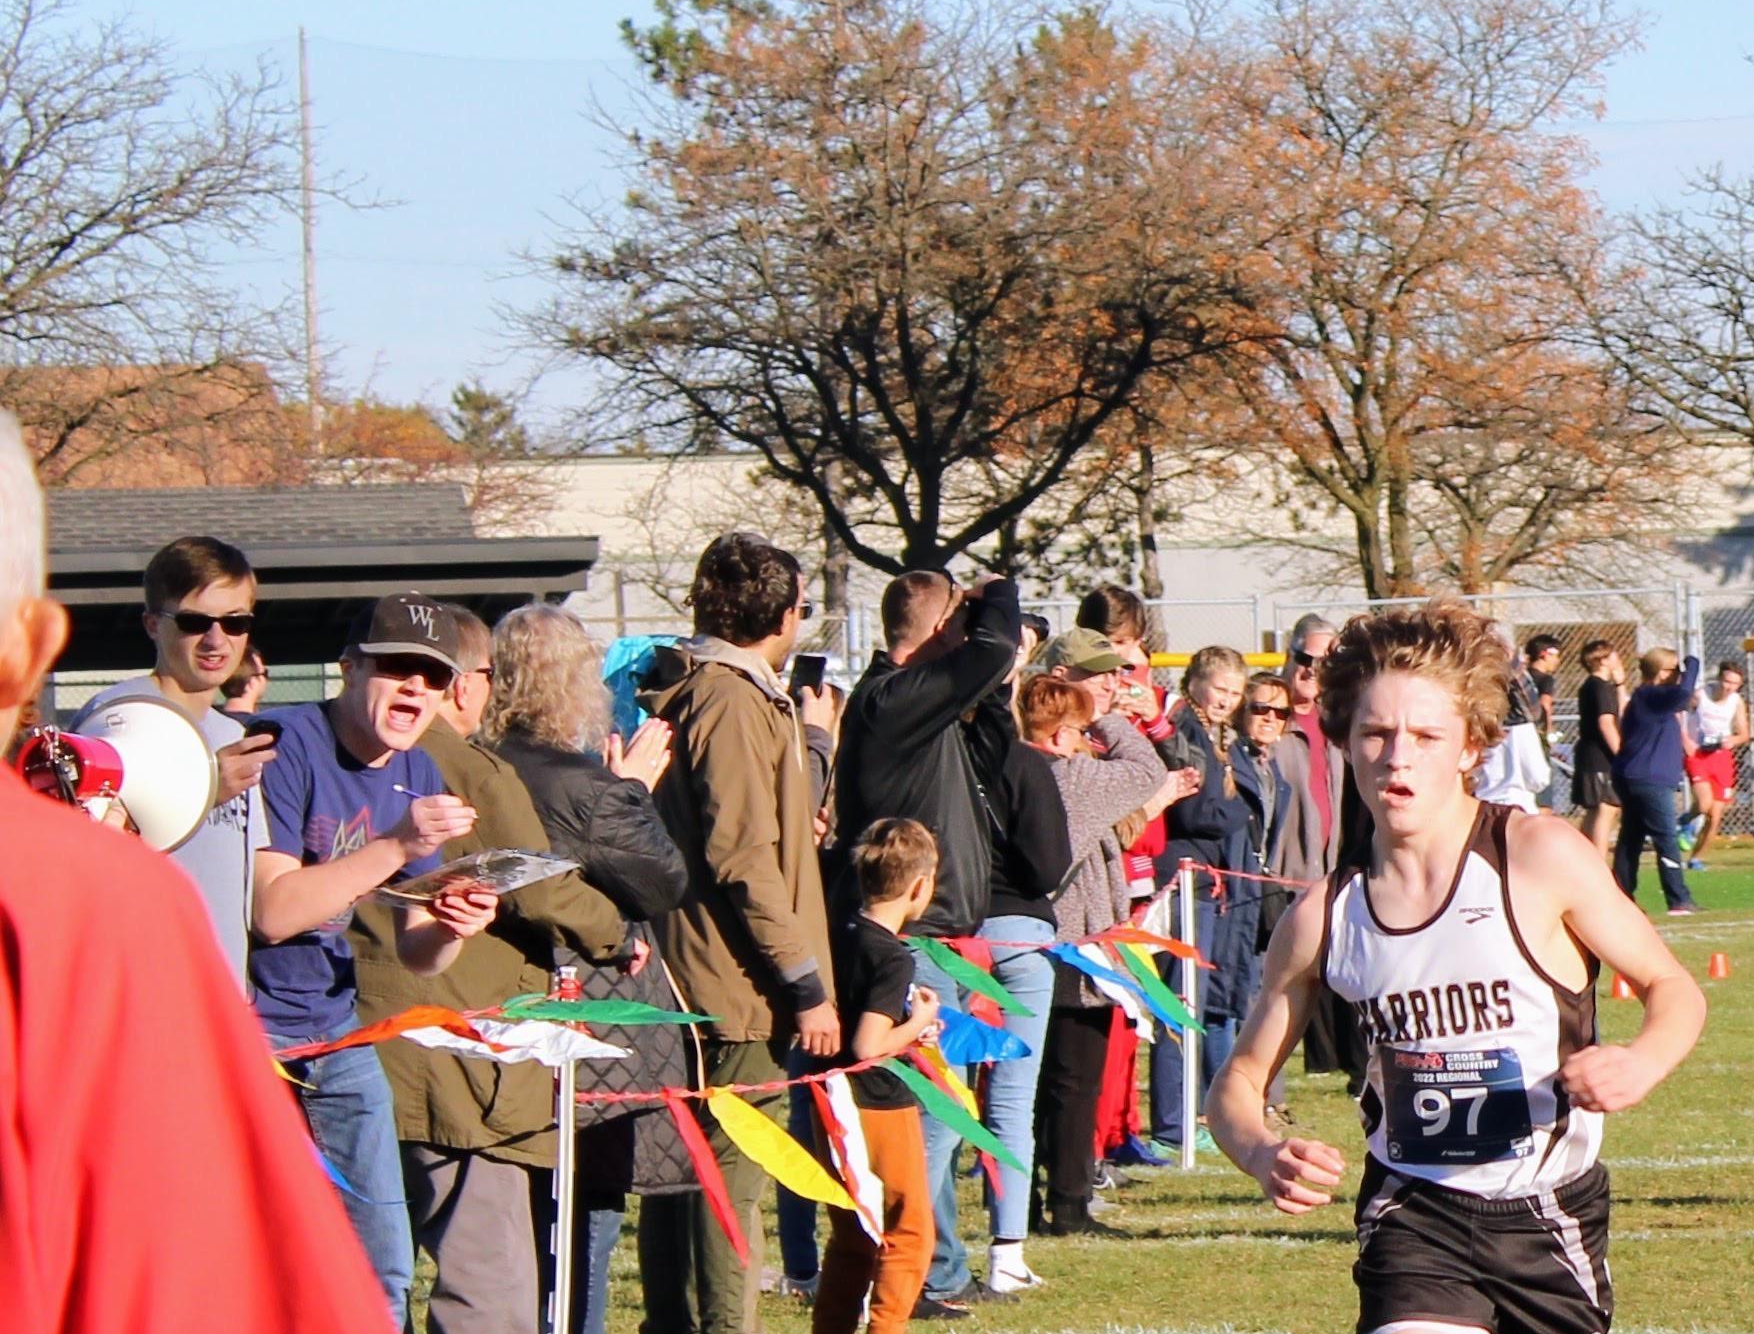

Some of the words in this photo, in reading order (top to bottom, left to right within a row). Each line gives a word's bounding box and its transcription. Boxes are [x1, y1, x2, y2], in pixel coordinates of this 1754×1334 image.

[405, 604, 440, 642] WL
[1445, 1052, 1484, 1062] CROSS
[1446, 1059, 1499, 1071] COUNTRY
[1413, 1087, 1488, 1136] 97
